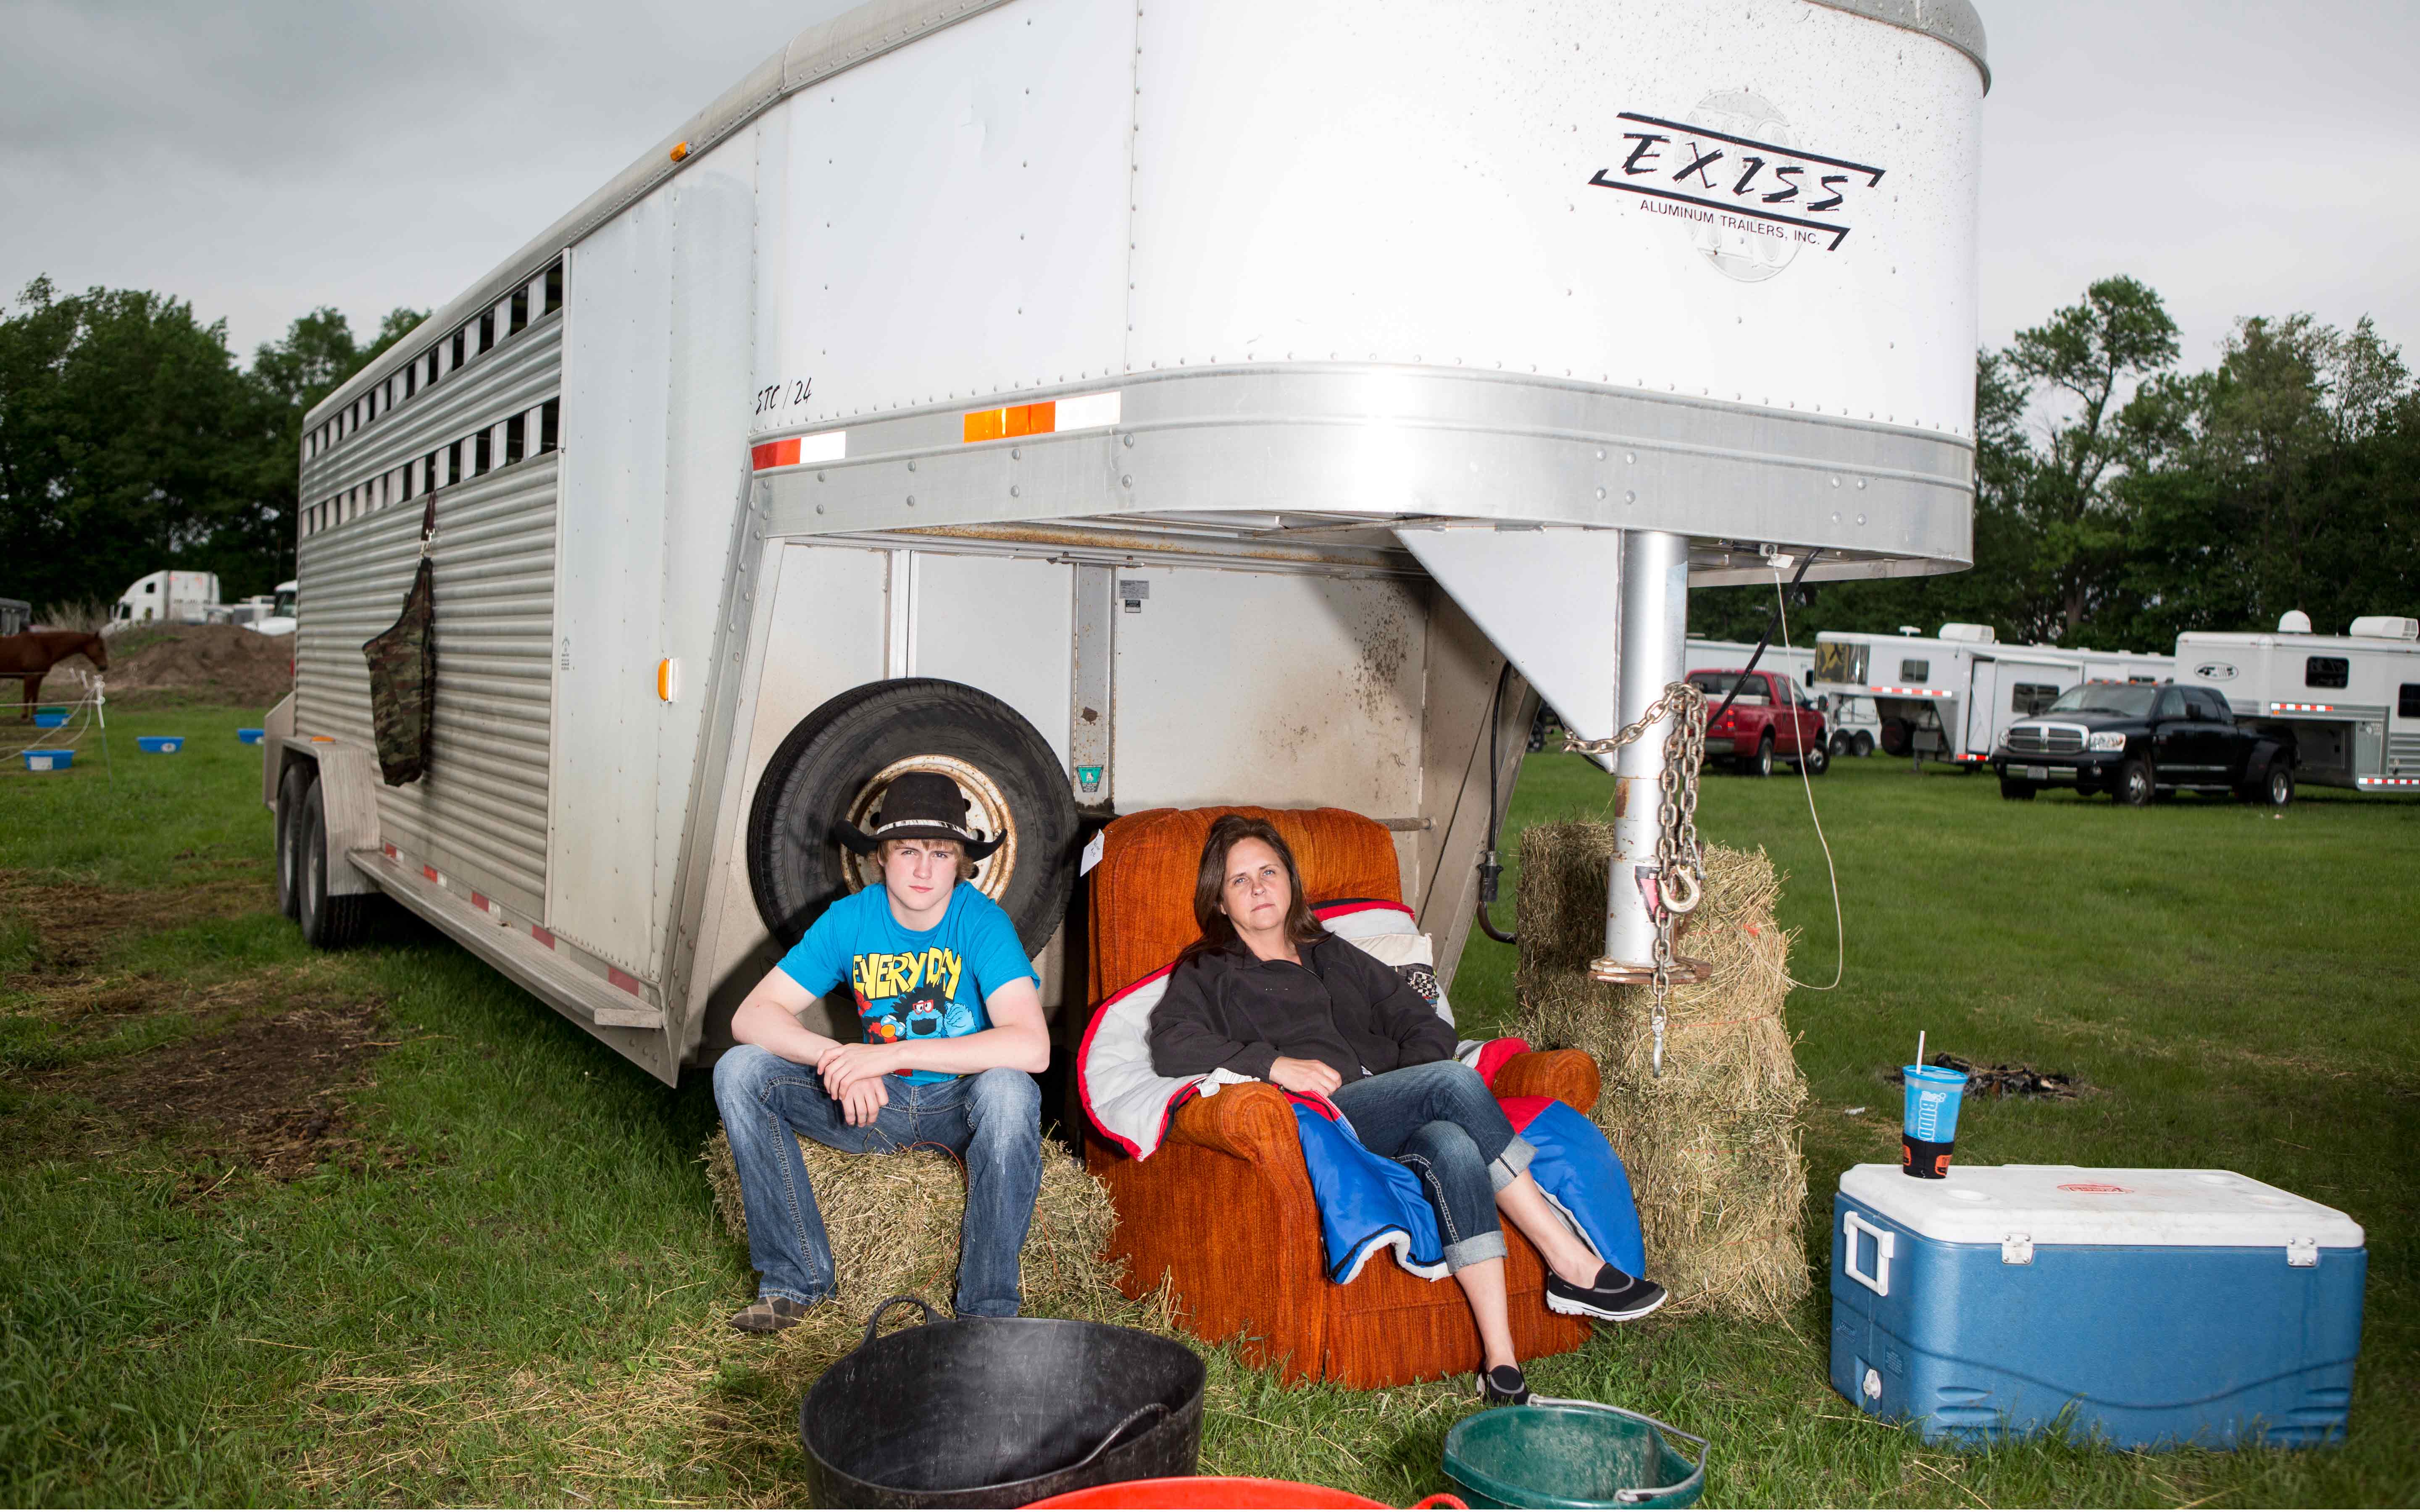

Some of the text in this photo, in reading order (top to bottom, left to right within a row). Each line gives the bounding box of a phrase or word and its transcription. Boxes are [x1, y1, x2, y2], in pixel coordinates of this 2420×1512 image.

[1622, 133, 1849, 212] EXISS
[1640, 200, 1820, 245] ALUMINUM TRAILERS, INC.
